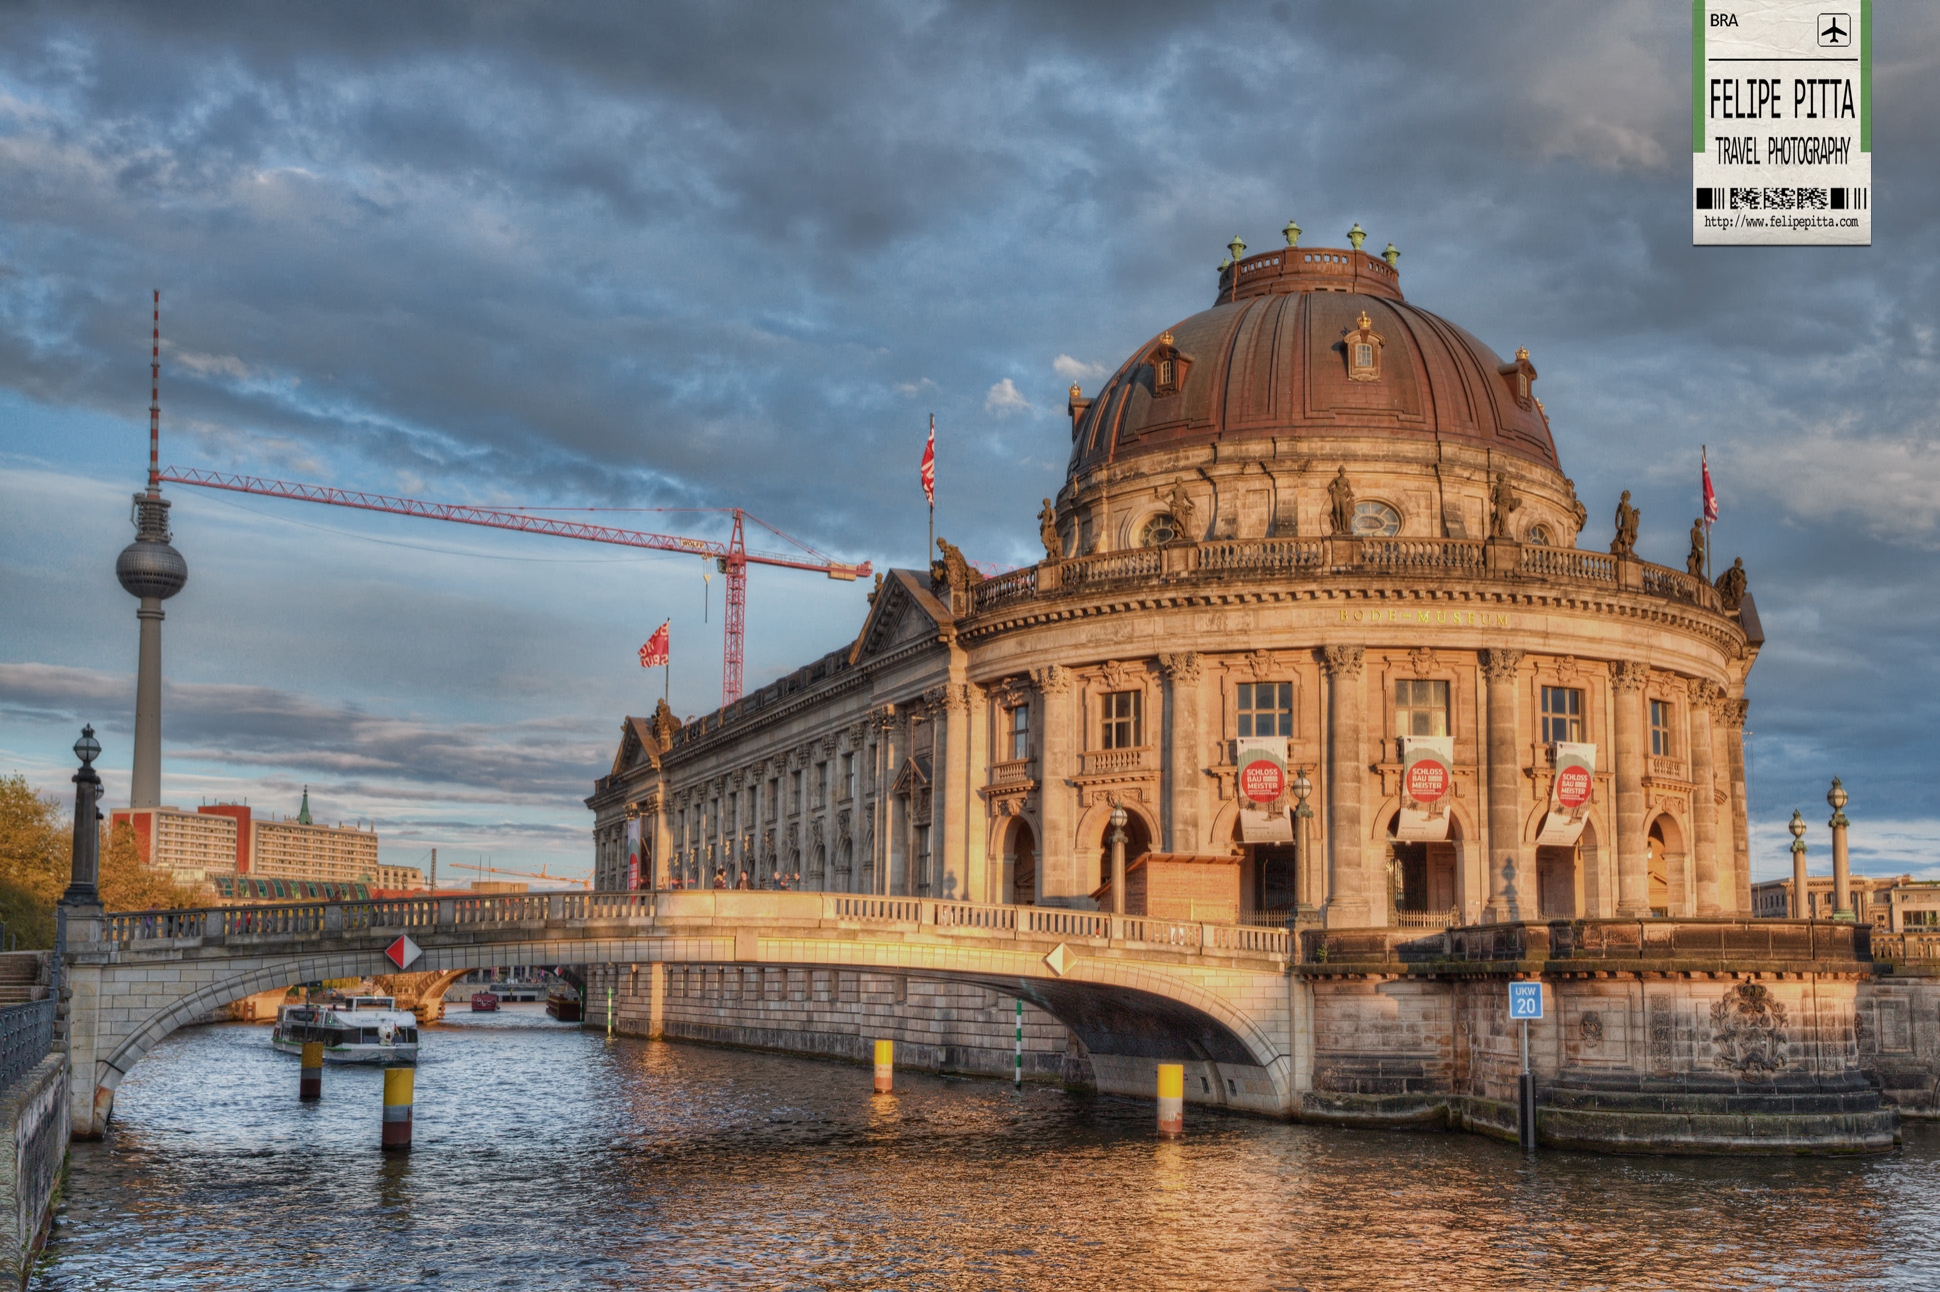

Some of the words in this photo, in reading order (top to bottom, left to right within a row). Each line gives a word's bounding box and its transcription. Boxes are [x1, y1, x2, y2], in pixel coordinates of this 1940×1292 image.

[1247, 768, 1278, 776] SCHLOSS
[1515, 986, 1536, 996] UKW
[1517, 998, 1536, 1014] 20
